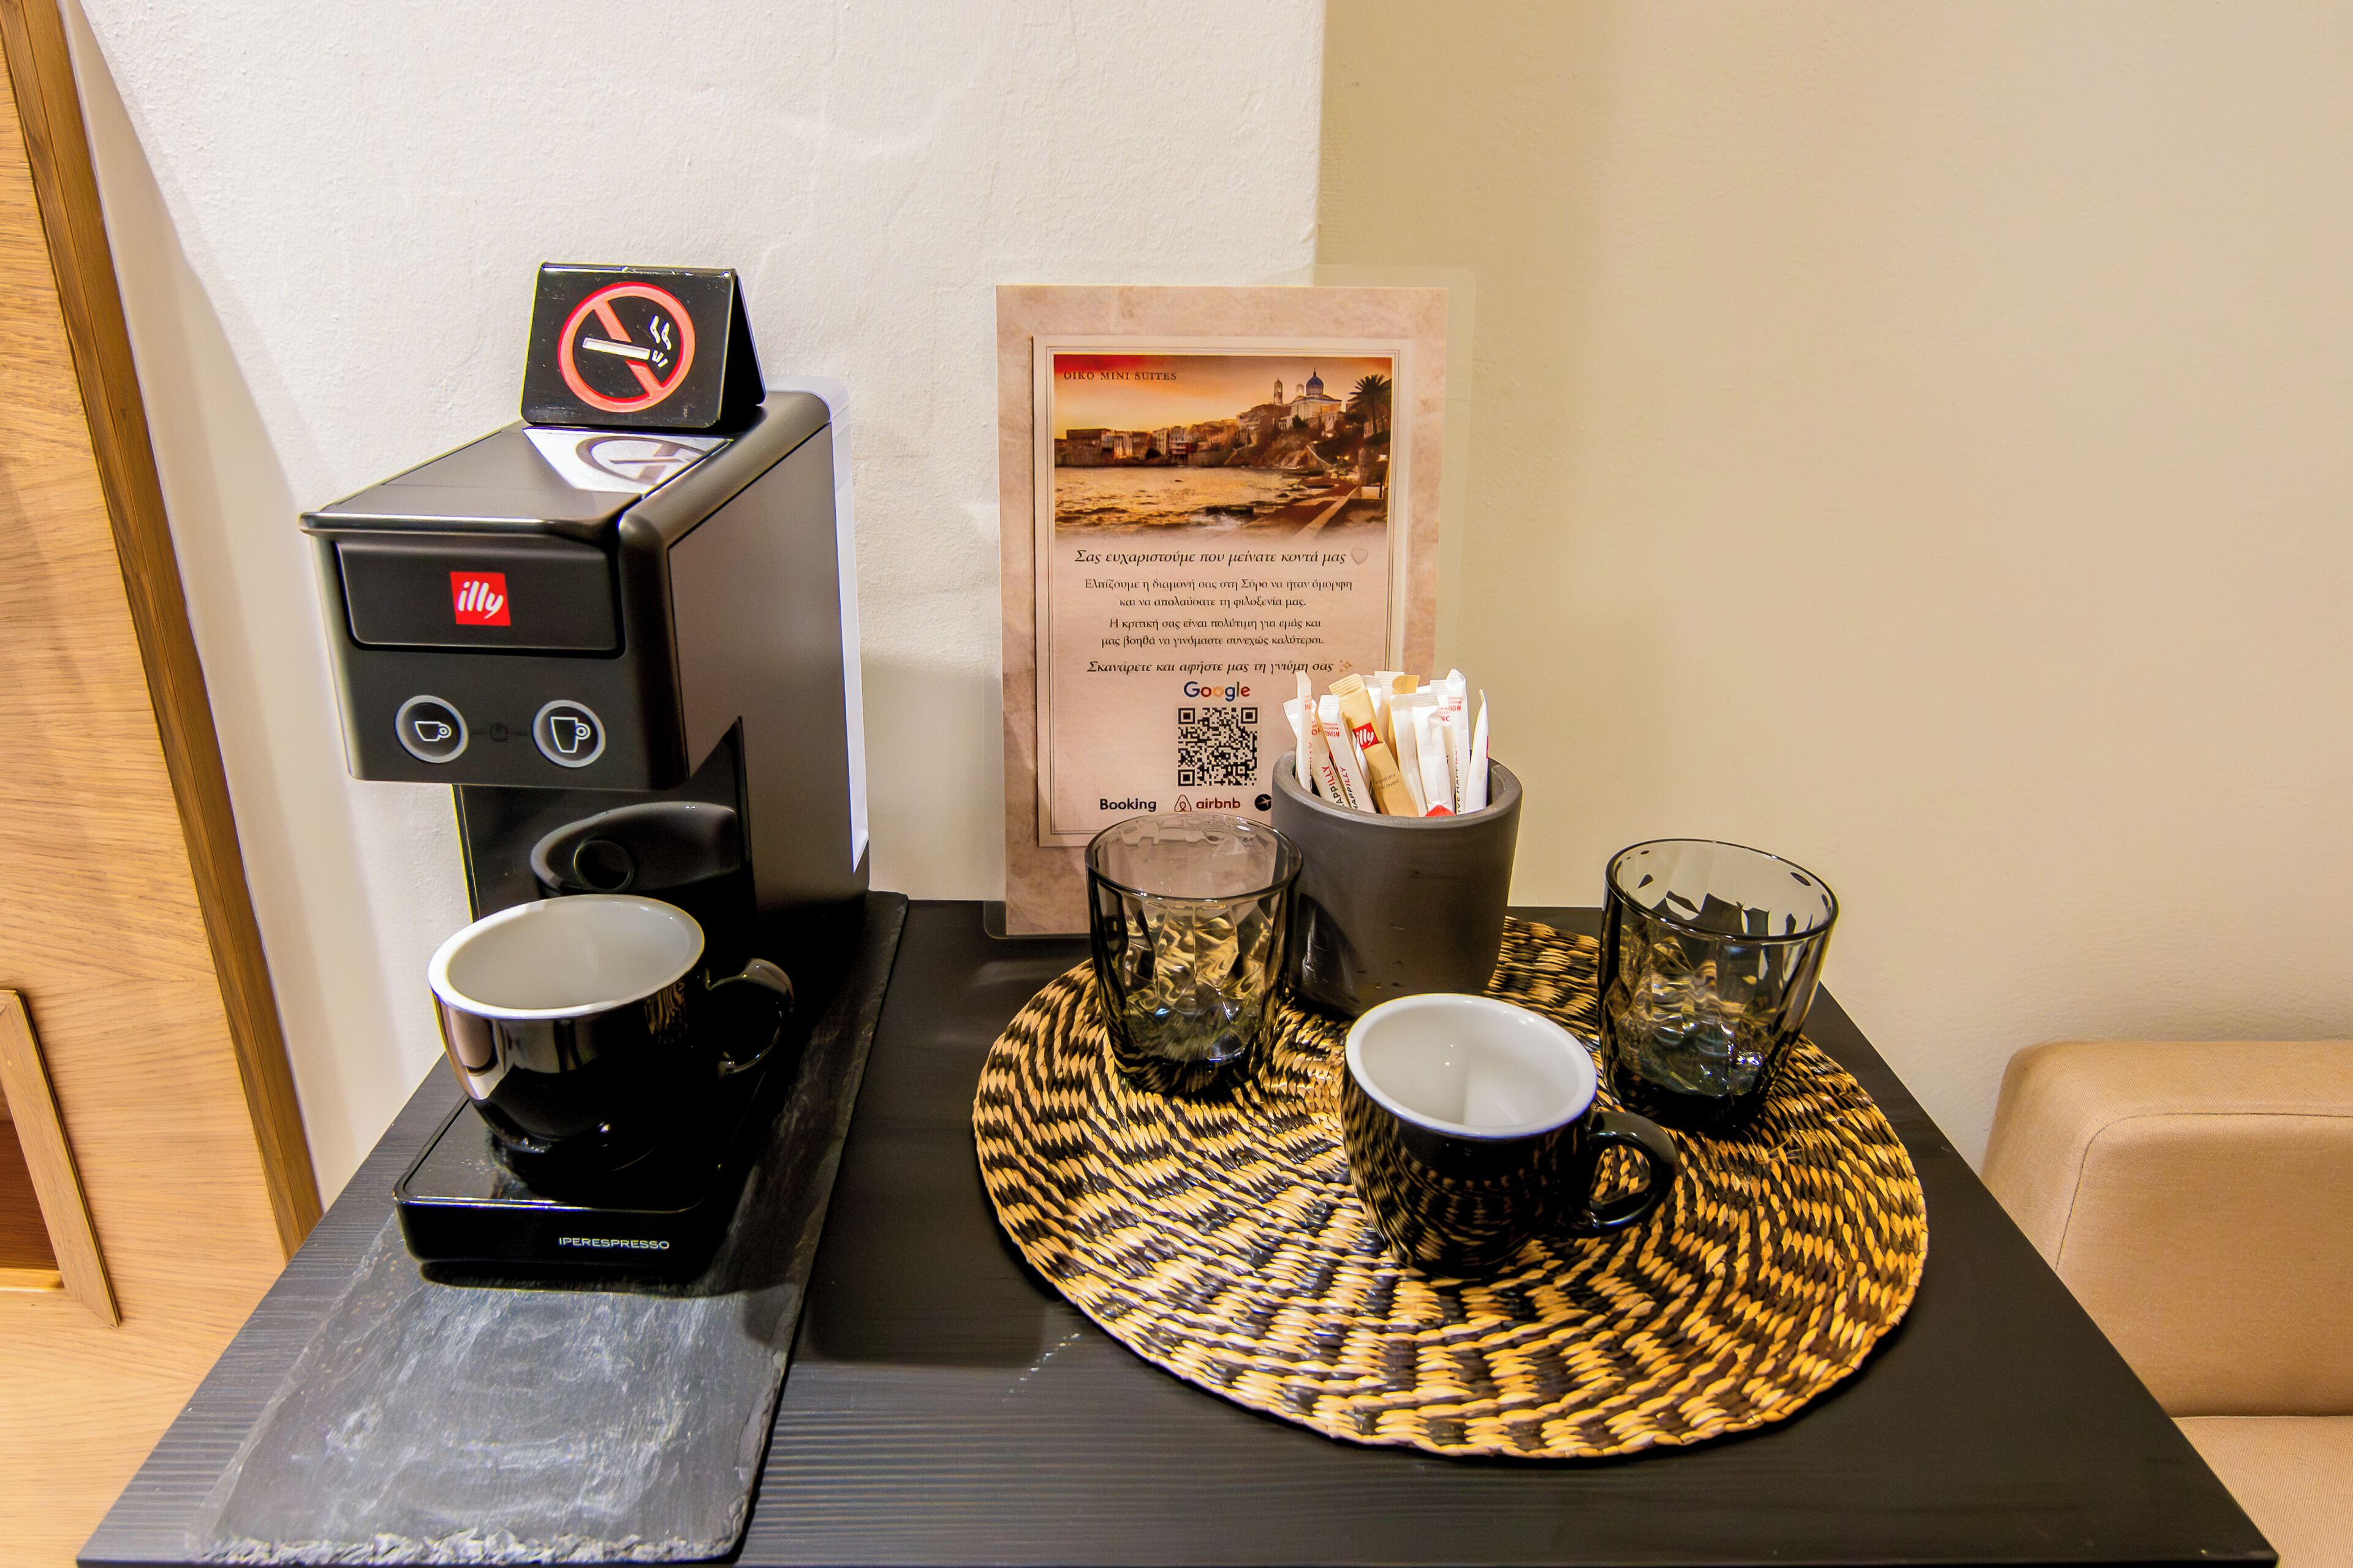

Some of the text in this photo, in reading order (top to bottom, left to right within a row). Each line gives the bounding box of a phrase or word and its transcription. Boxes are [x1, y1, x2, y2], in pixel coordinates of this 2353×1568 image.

[1063, 371, 1177, 381] OIKO MINI SUITES
[1074, 550, 1347, 567] Σας ευχαριστούμε που μείνατε κοντά μας
[1142, 581, 1150, 593] η
[1198, 581, 1217, 590] σας
[1219, 581, 1238, 592] στη
[1240, 578, 1268, 592] Σύρο
[1312, 578, 1352, 592] όμορφη
[458, 580, 504, 619] illy
[1218, 599, 1230, 609] τη
[1233, 595, 1282, 609] φιλοξενία
[1286, 599, 1306, 609] μας.
[1121, 618, 1159, 632] κριτική
[1162, 621, 1180, 630] σας
[1183, 618, 1208, 628] είναι
[1210, 617, 1257, 631] πολύτιμη
[1259, 620, 1276, 631] για
[1279, 618, 1303, 631] εμάς
[1101, 638, 1120, 649] μας
[1123, 634, 1156, 648] βοηθά
[1173, 635, 1224, 648] γινόμαστε
[1226, 635, 1269, 646] συνεχώς
[1086, 661, 1153, 676] Σκανάρετε
[1179, 660, 1224, 675] αφήστε
[1226, 664, 1250, 675] μας
[1254, 663, 1267, 674] τη
[1312, 663, 1334, 673] σας
[1183, 681, 1251, 702] Google
[1356, 728, 1374, 746] illy
[1321, 765, 1345, 806] APPILLY
[1099, 797, 1157, 812] Booking
[1195, 797, 1241, 809] airbnb
[558, 1237, 670, 1250] IPERESPRESSO
